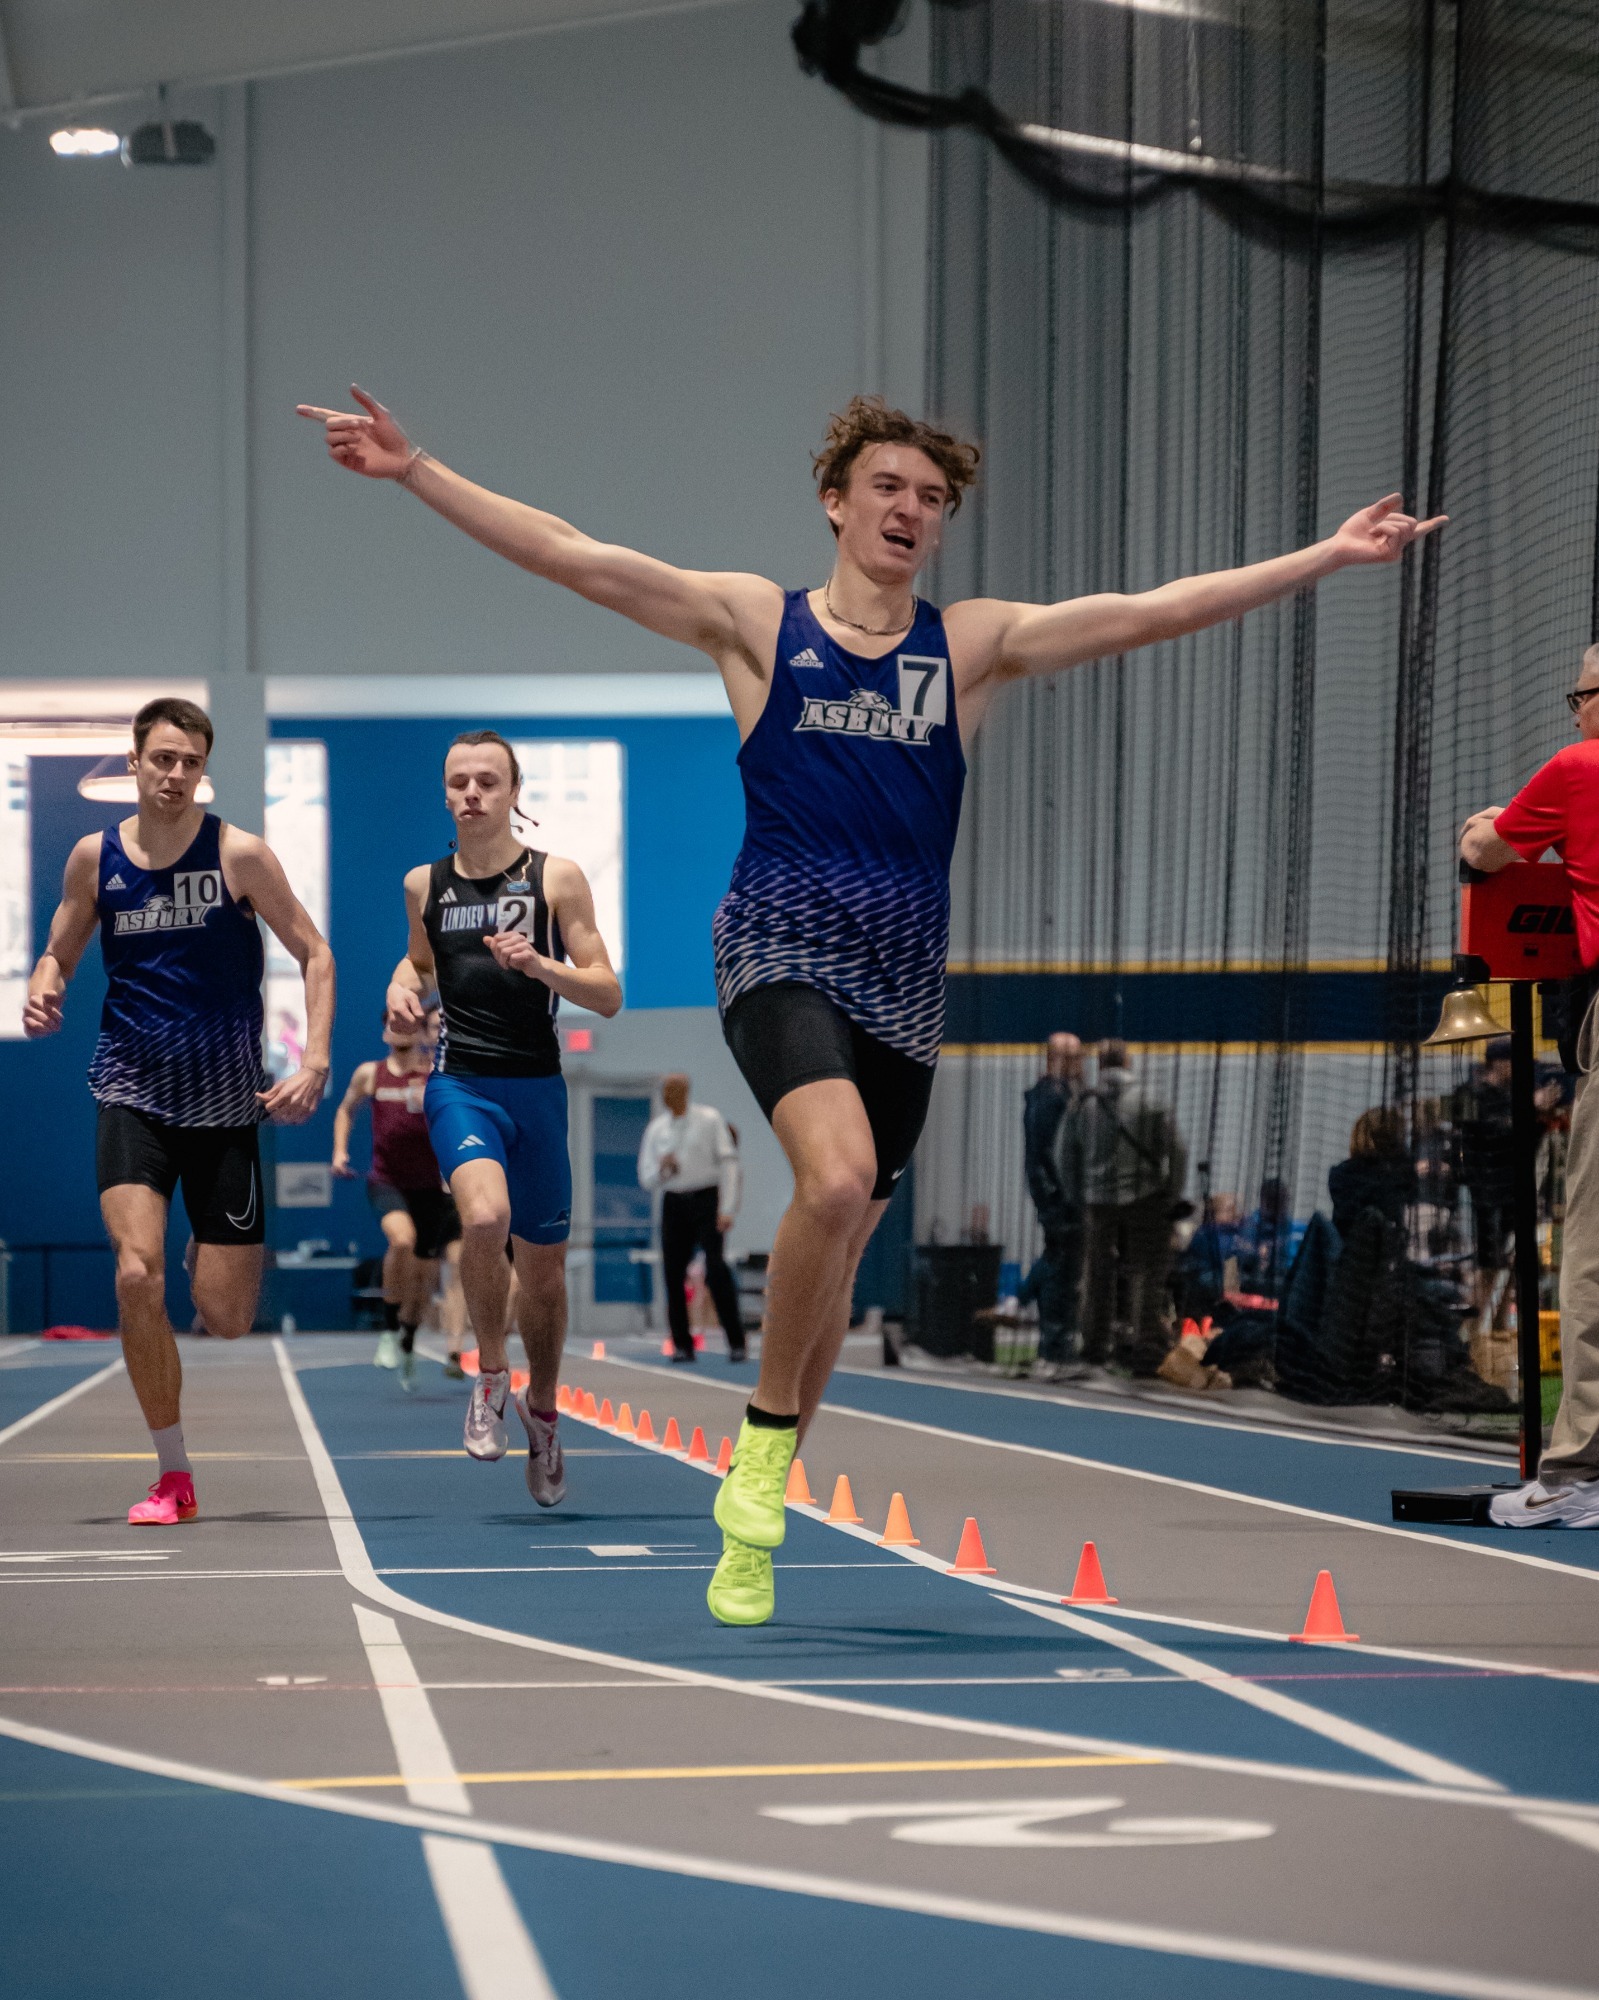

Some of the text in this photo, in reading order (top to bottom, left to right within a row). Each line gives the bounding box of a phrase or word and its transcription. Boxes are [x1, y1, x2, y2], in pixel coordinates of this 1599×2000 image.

[789, 658, 825, 669] adidas
[903, 660, 939, 716] 7
[177, 873, 218, 906] 10
[115, 906, 209, 934] ASBURY
[440, 904, 485, 932] LINDSEY
[503, 899, 528, 938] 2
